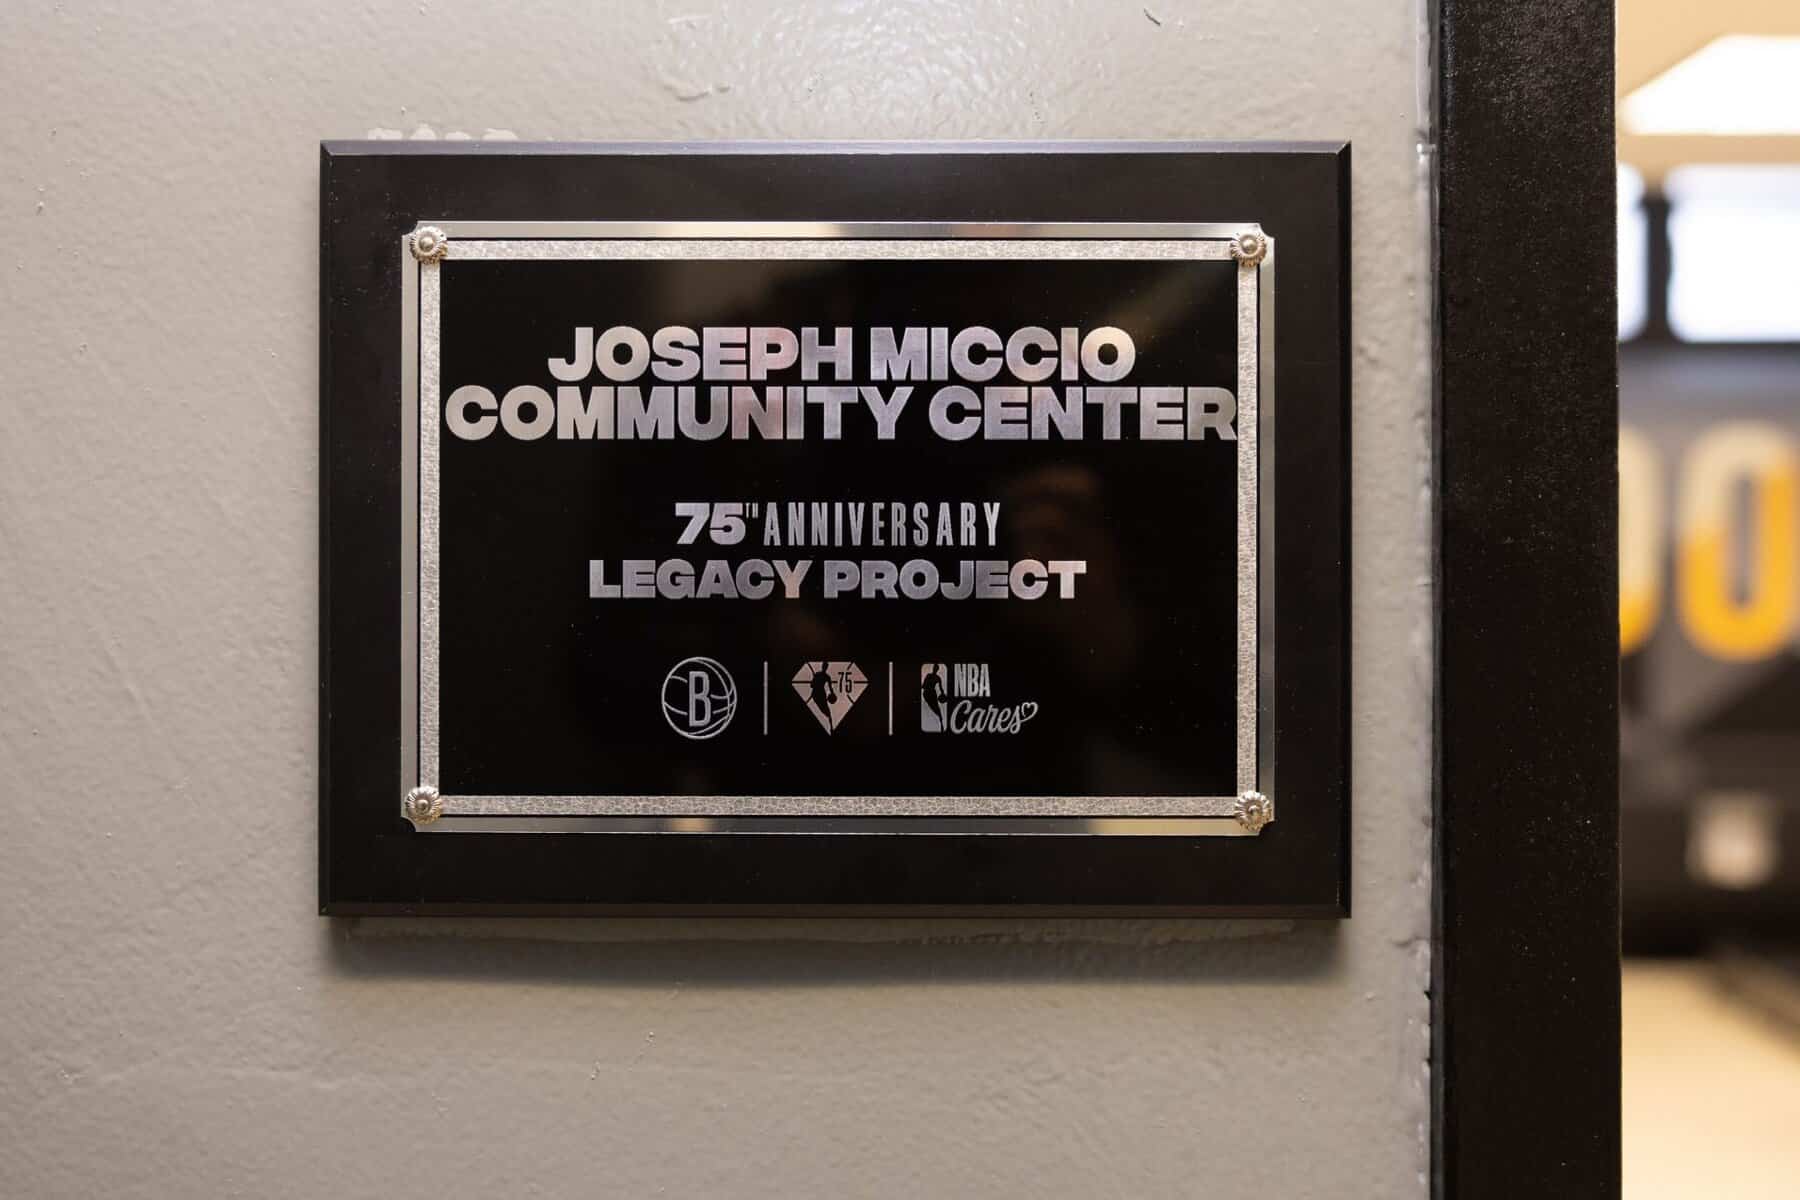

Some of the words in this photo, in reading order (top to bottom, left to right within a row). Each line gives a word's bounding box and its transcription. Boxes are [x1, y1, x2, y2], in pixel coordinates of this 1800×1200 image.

[547, 325, 853, 382] JOSEPH
[869, 325, 1137, 383] MICCIO
[444, 384, 914, 441] COMMUNITY
[928, 384, 1238, 441] CENTER
[763, 501, 1002, 547] ANNIVERSARY
[588, 558, 813, 600] LEGACY
[823, 558, 1087, 600] PROJECT
[837, 671, 854, 694] 75
[954, 663, 991, 698] NBA
[949, 700, 1021, 735] Cares
